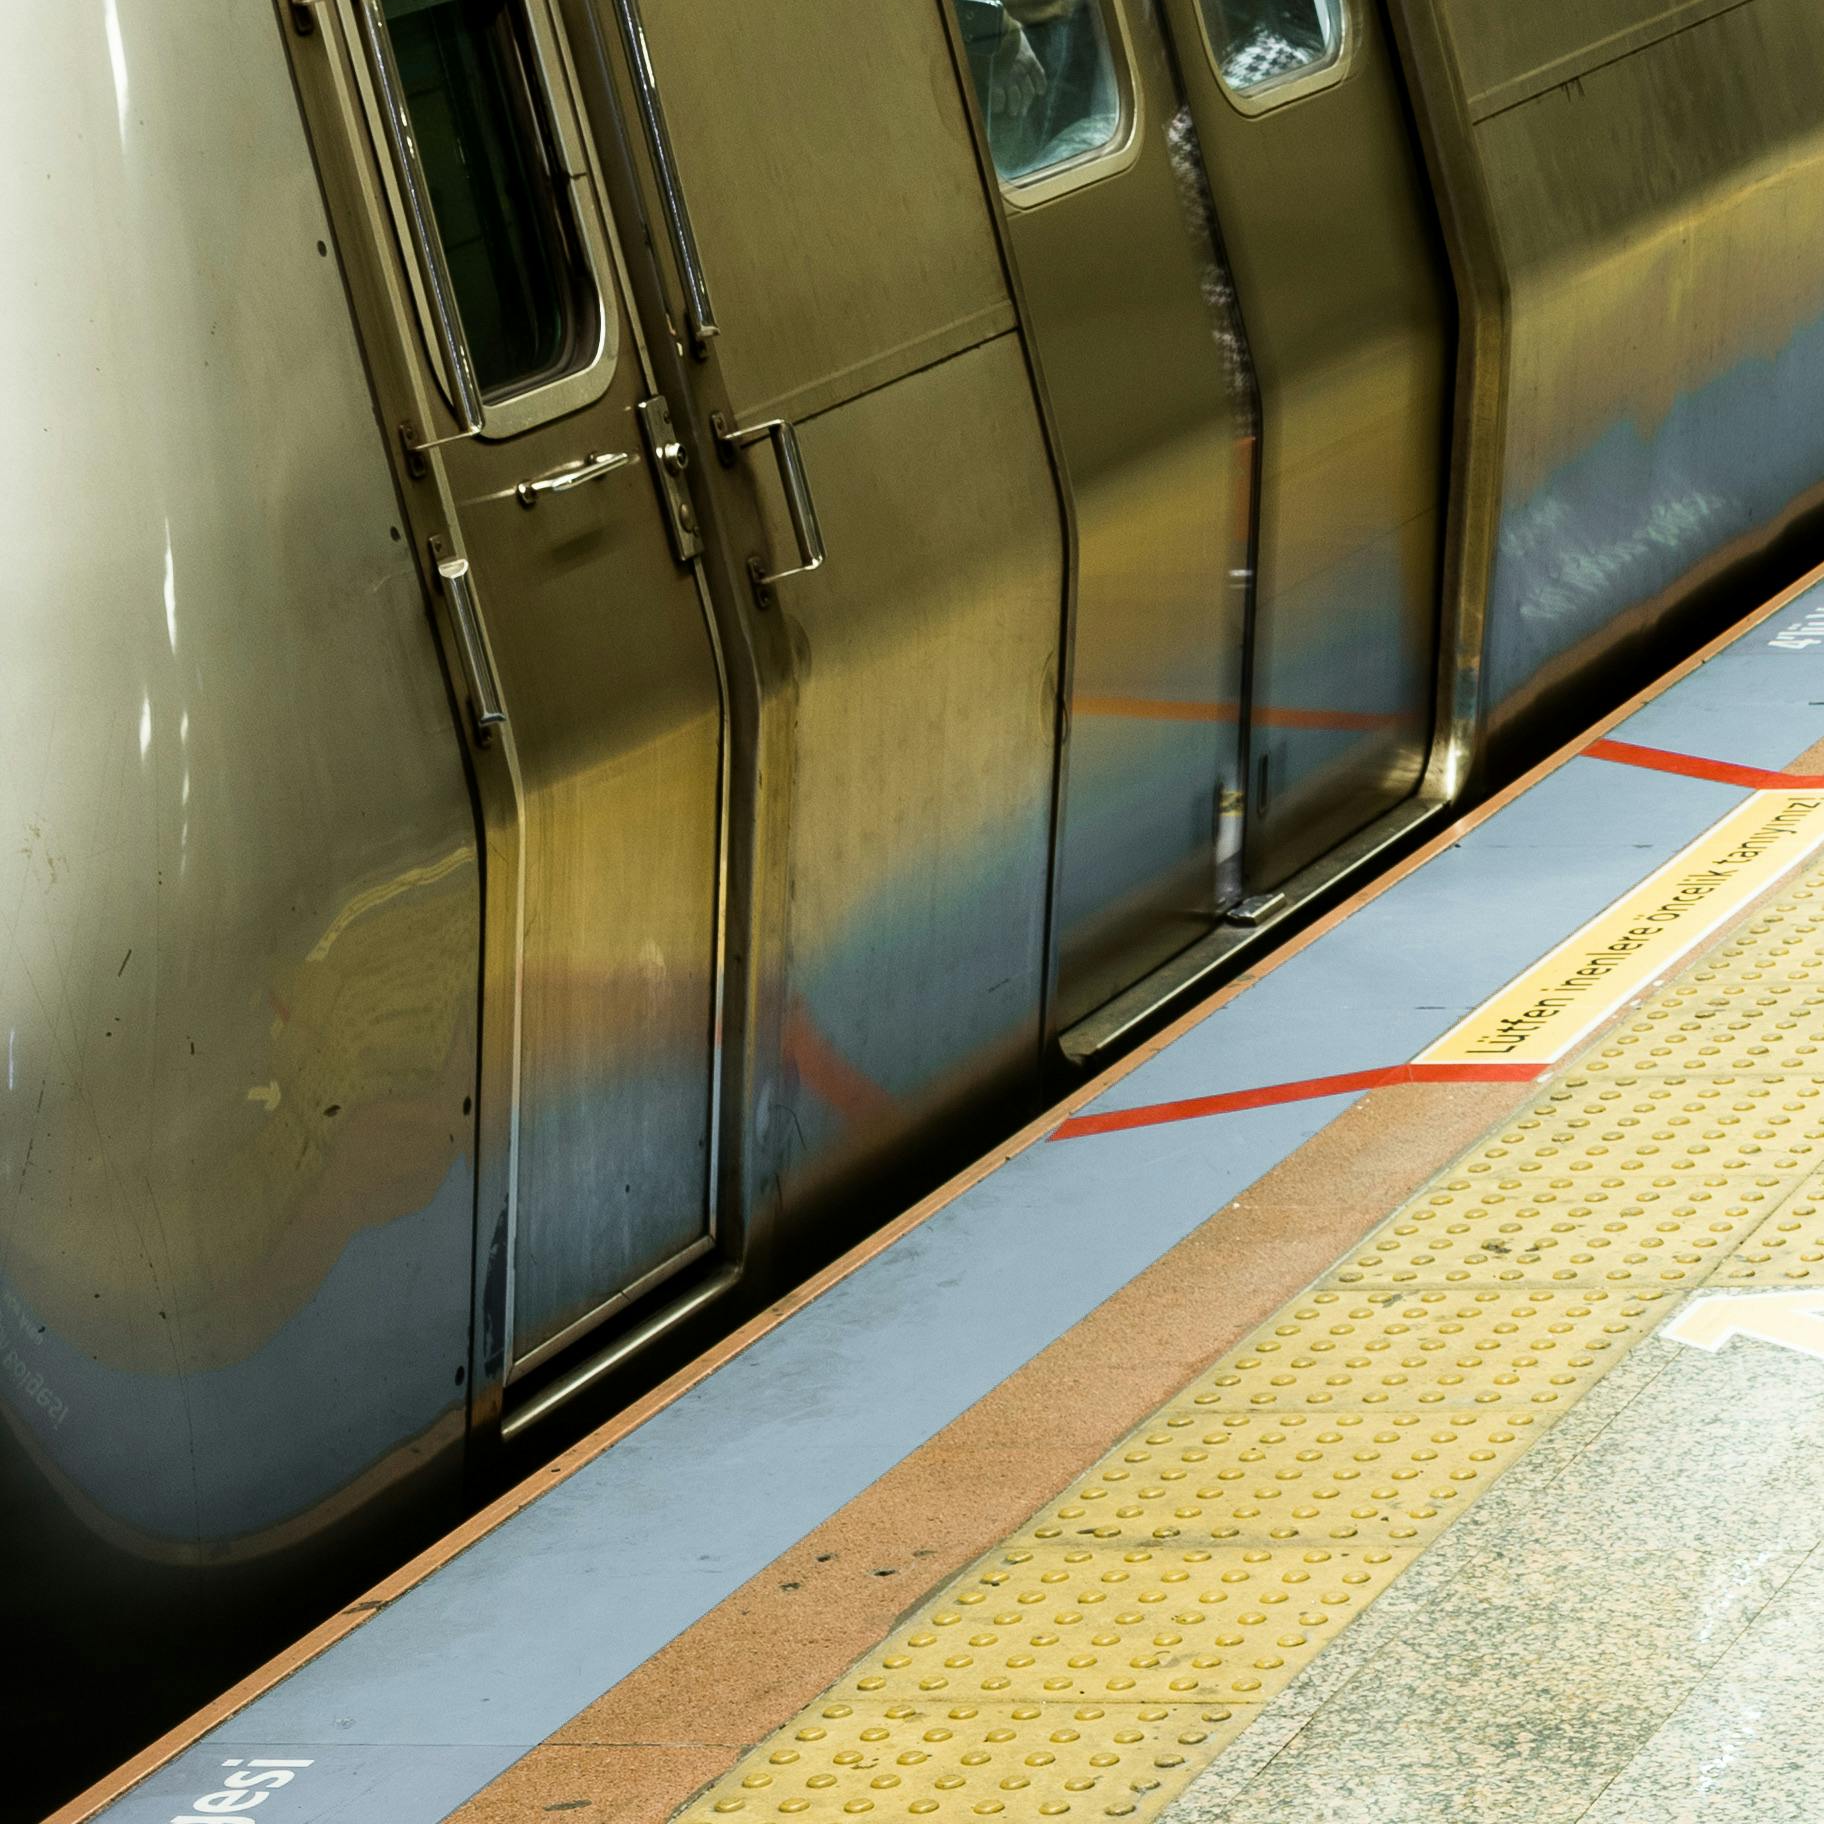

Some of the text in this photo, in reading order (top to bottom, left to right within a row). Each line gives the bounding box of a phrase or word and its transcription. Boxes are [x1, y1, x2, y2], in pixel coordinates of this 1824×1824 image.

[1465, 997, 1566, 1054] Lütfen
[1541, 926, 1662, 992] inenlere
[1634, 868, 1738, 921] öncelik
[170, 1759, 315, 1824] esi
